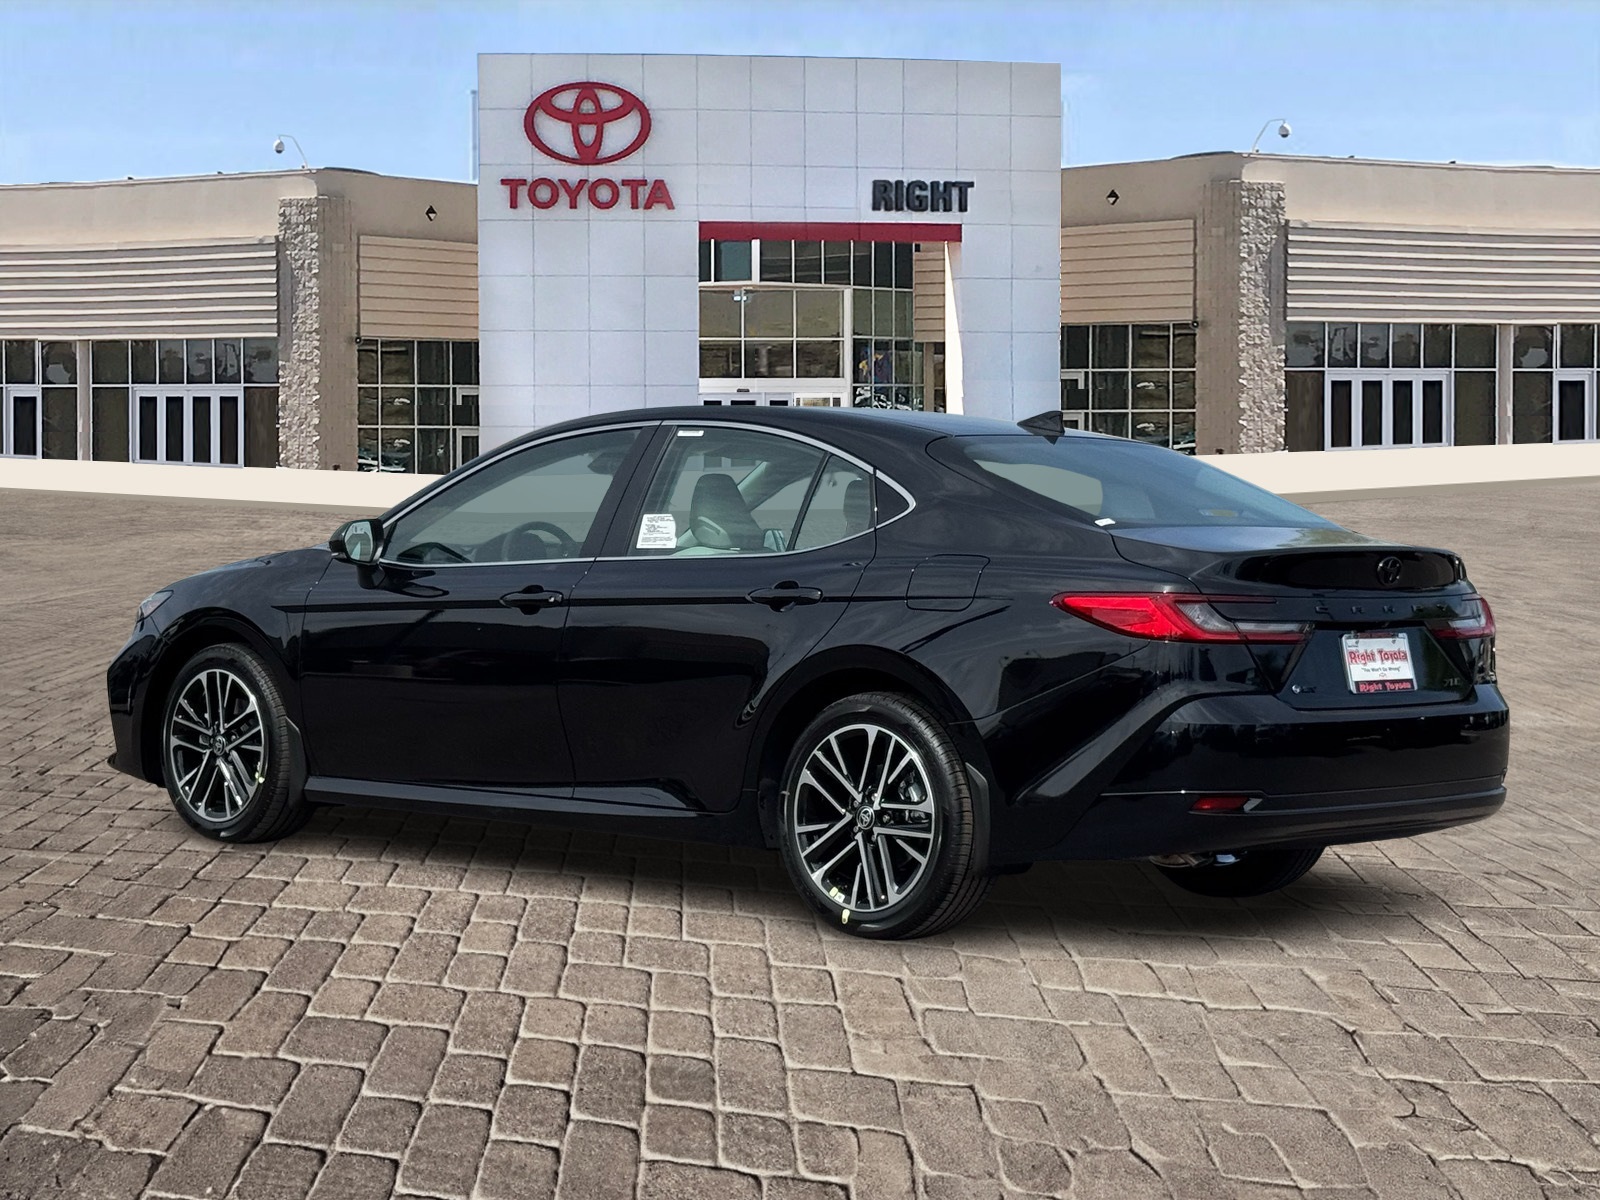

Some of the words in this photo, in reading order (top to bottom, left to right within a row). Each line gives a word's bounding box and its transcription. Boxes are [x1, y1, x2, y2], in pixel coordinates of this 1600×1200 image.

[500, 177, 675, 209] TOYOTA
[872, 179, 975, 212] RIGHT
[1348, 650, 1375, 665] Right
[1378, 649, 1408, 663] Toyota
[1359, 683, 1382, 692] Right
[1385, 682, 1411, 690] Toyota
